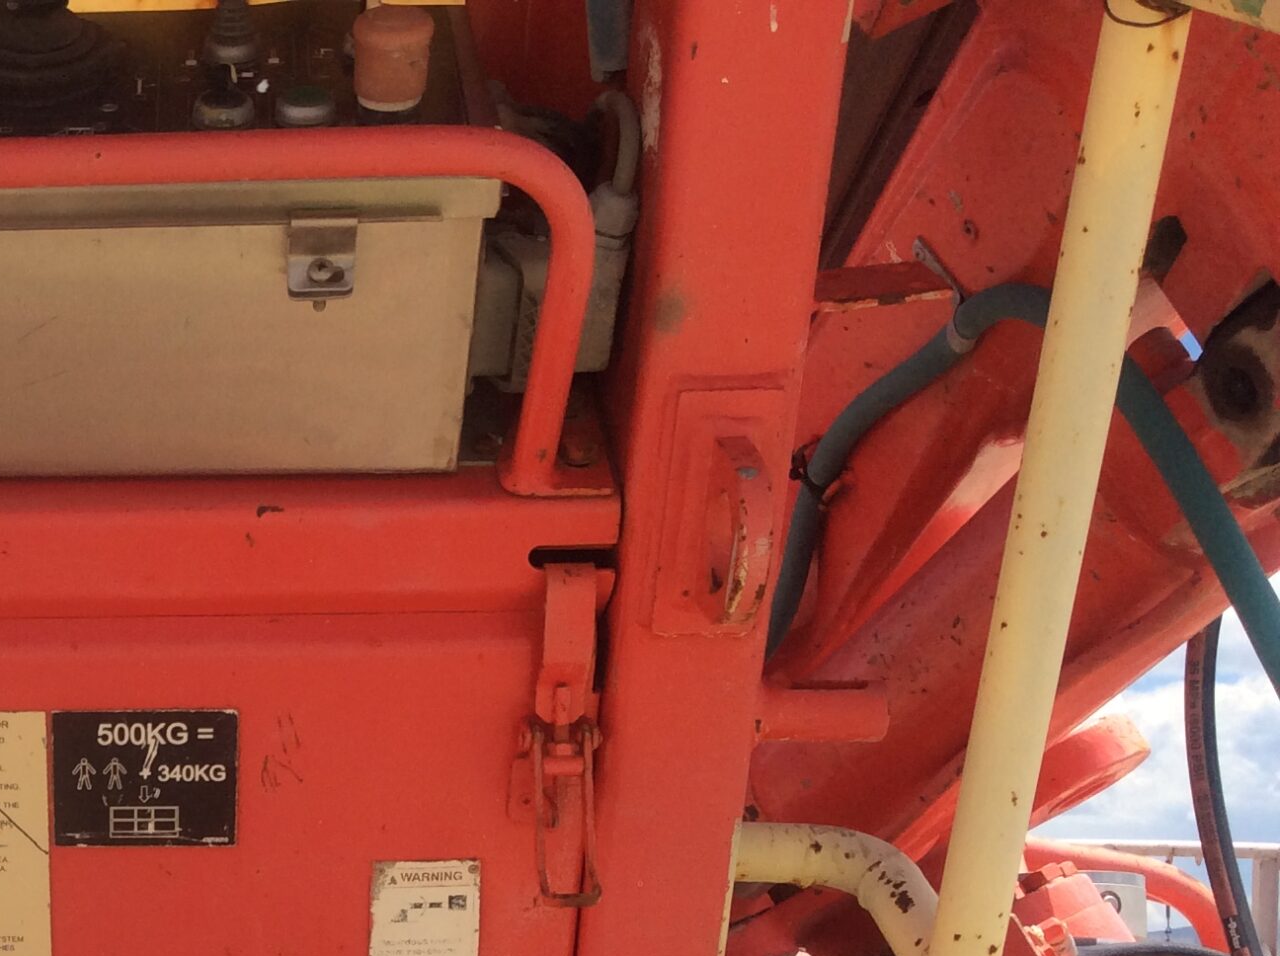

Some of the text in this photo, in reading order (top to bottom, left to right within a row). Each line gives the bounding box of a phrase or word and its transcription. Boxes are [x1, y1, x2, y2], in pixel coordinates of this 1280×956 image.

[97, 723, 189, 746] 500KG
[158, 764, 227, 782] 340KG
[400, 871, 463, 882] WARNING
